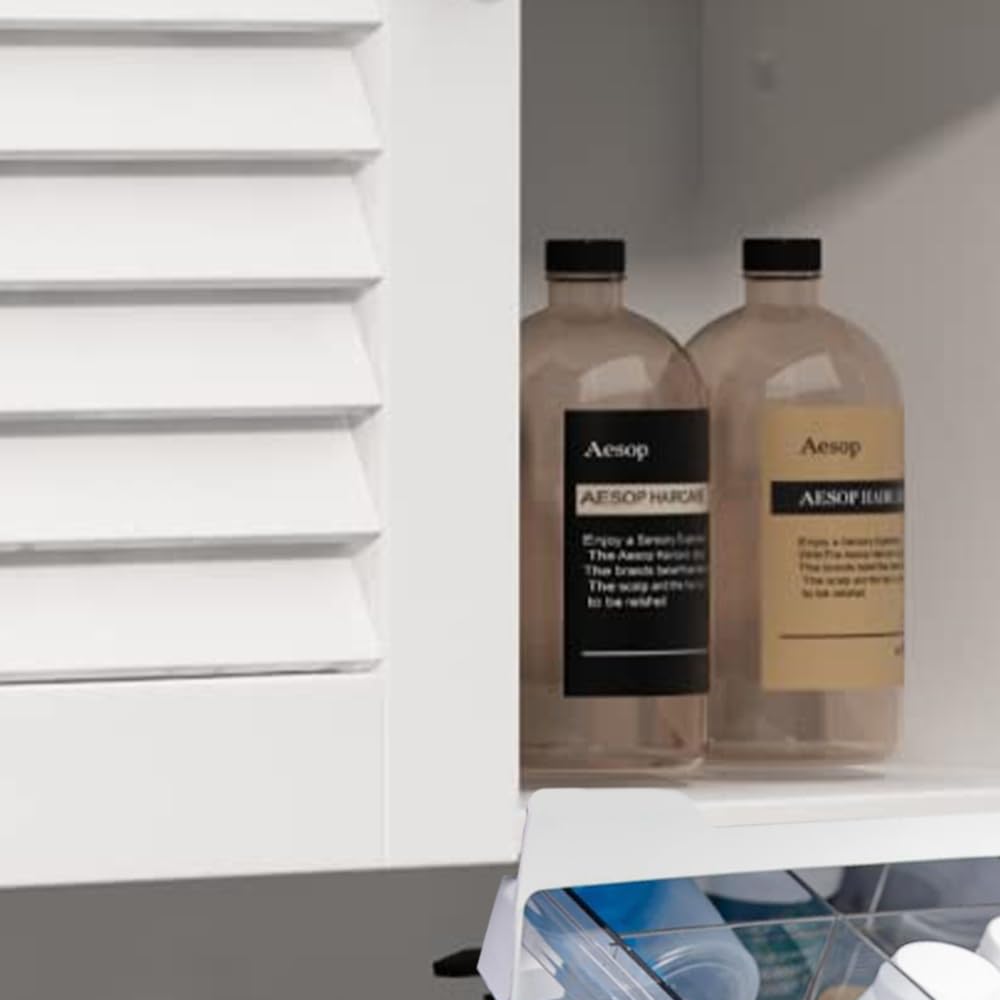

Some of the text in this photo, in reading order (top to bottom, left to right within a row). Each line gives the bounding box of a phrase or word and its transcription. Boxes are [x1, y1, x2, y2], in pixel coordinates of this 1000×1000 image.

[583, 441, 649, 461] Aesop
[801, 437, 861, 459] Aesop
[799, 491, 859, 507] AESOP
